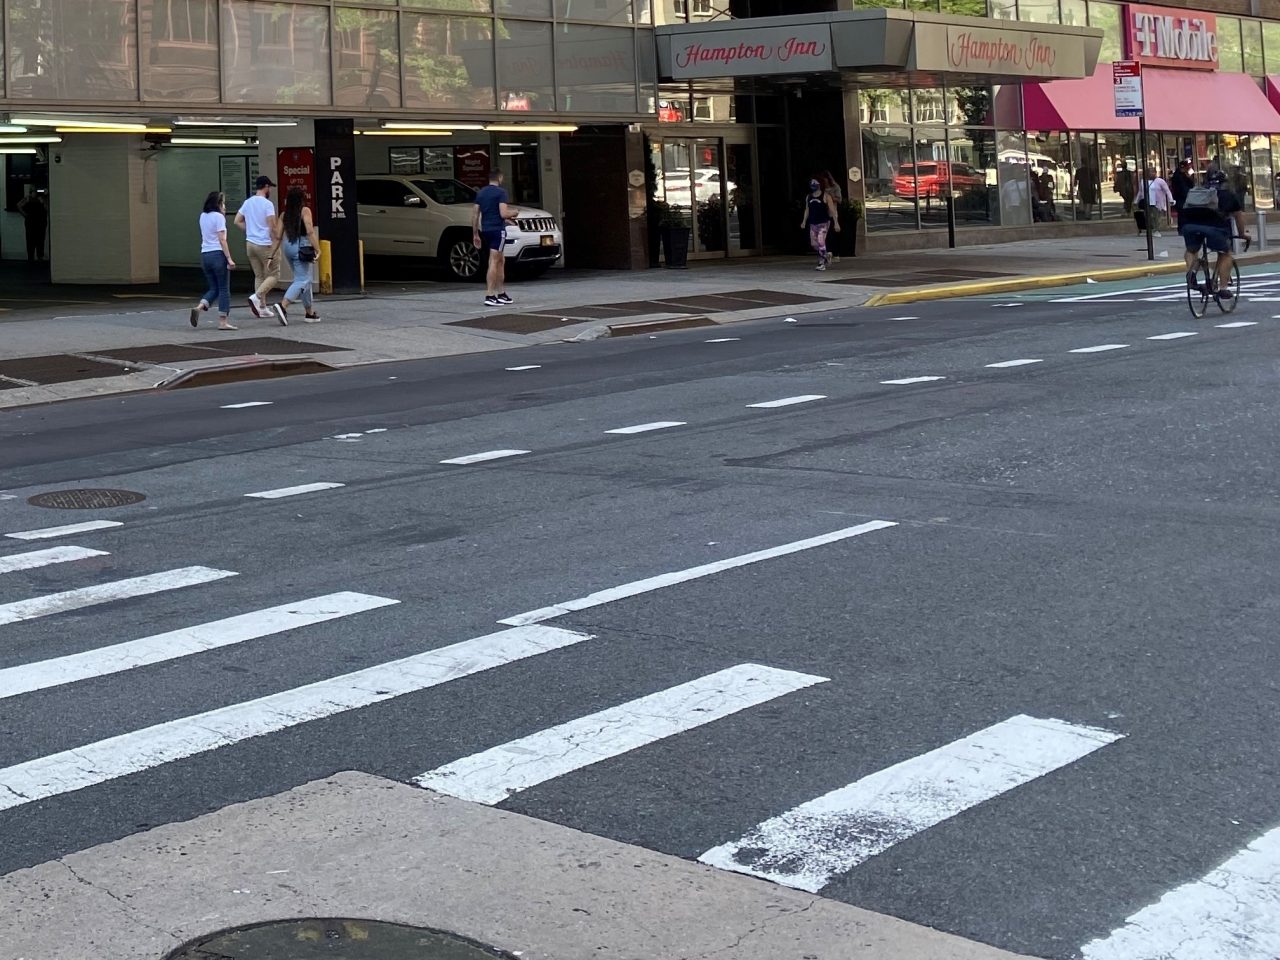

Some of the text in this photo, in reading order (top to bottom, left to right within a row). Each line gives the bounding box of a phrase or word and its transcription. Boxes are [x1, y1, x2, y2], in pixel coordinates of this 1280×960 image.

[676, 37, 826, 69] Hampton Inn
[951, 32, 1056, 71] Hampton Inn
[283, 165, 310, 176] Special
[330, 156, 344, 212] PARK
